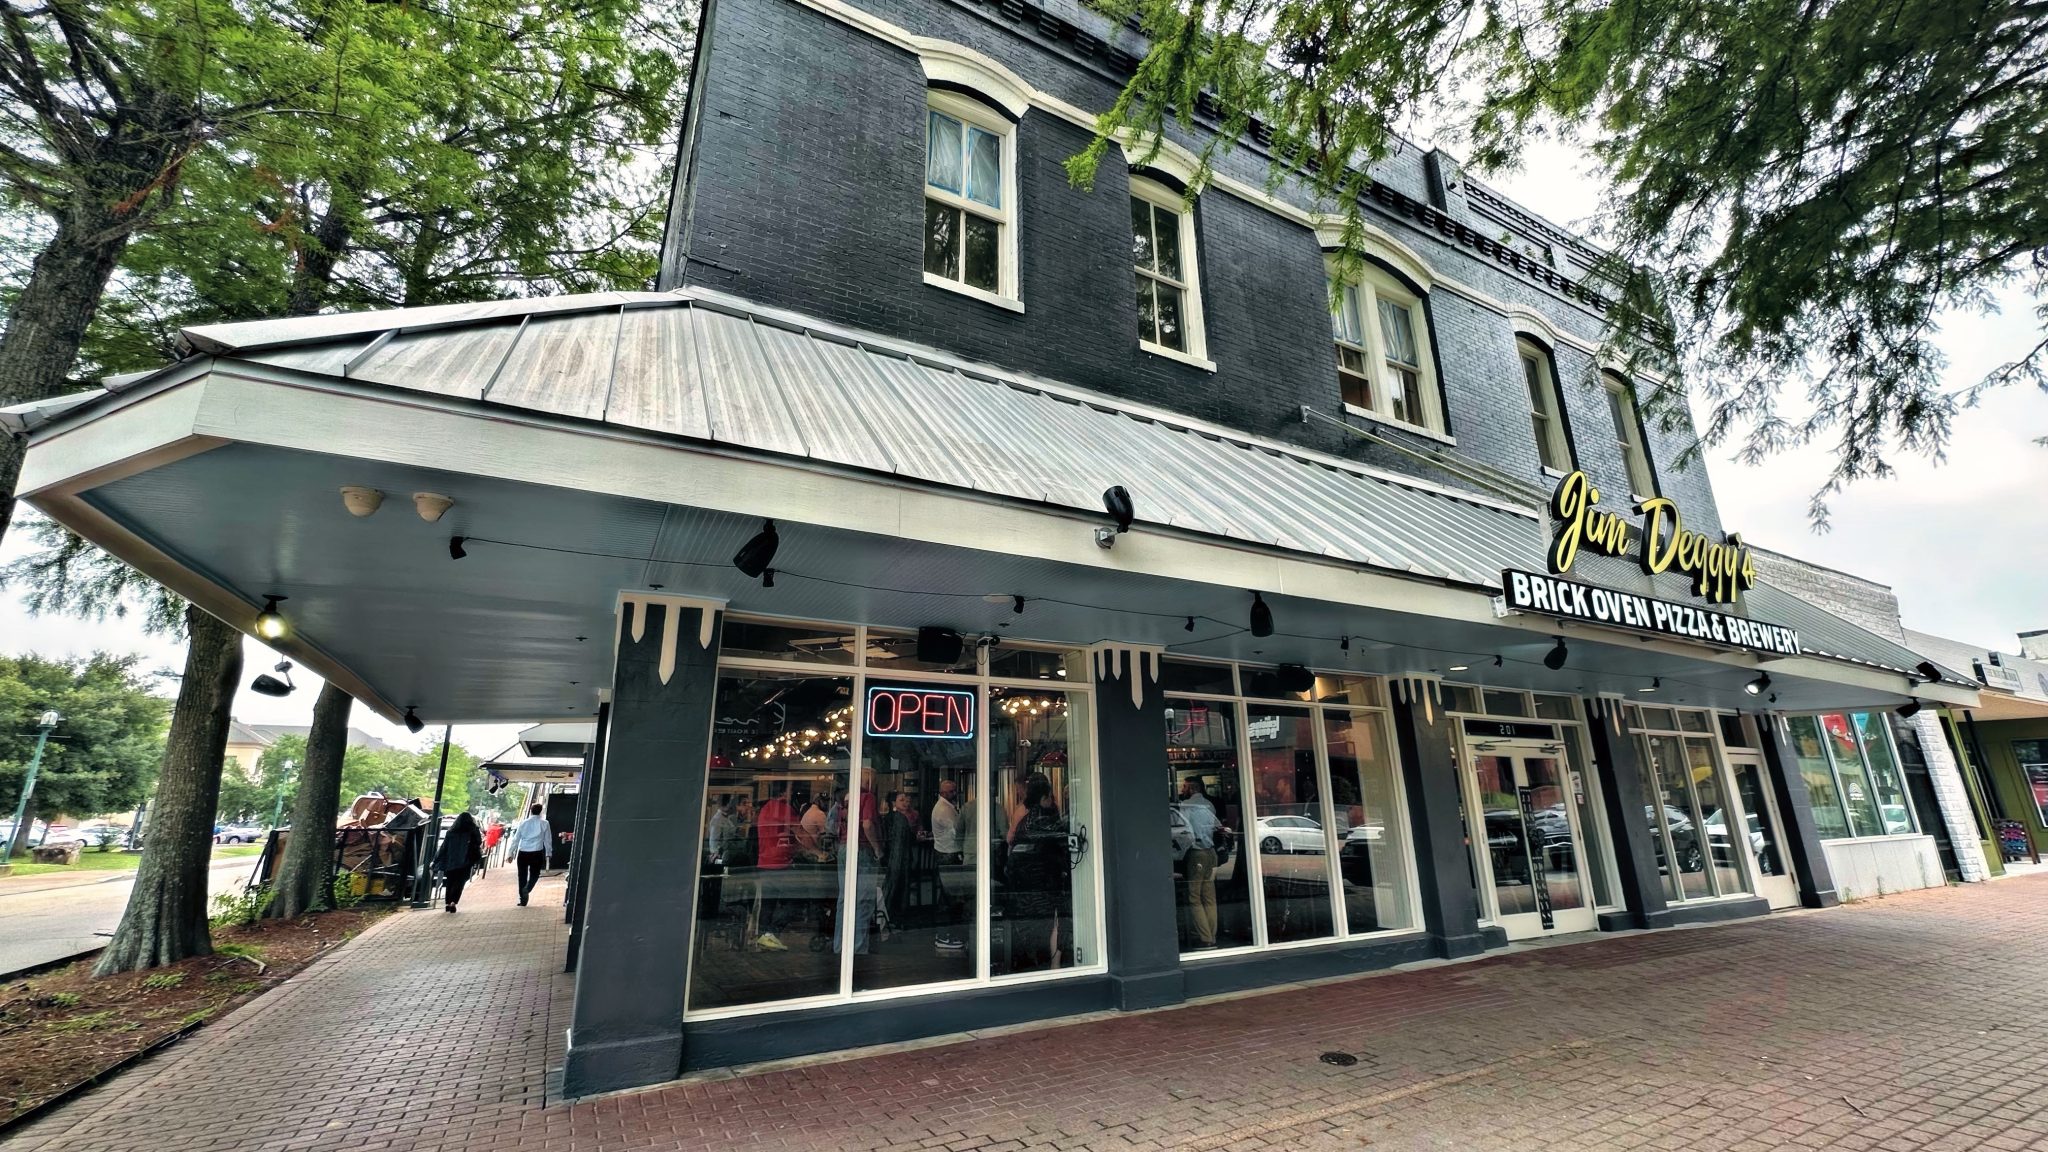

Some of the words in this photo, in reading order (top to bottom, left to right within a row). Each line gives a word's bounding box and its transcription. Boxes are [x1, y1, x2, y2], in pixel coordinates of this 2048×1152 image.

[1556, 470, 1630, 573] Jim
[1640, 497, 1757, 603] Deggy's
[1511, 572, 1597, 617] BRICK
[1591, 587, 1652, 628] OVEN
[1653, 599, 1714, 640] PIZZA
[1711, 613, 1724, 639] &
[1725, 616, 1801, 655] BREWERY
[872, 692, 969, 734] OPEN
[1499, 724, 1516, 736] 201
